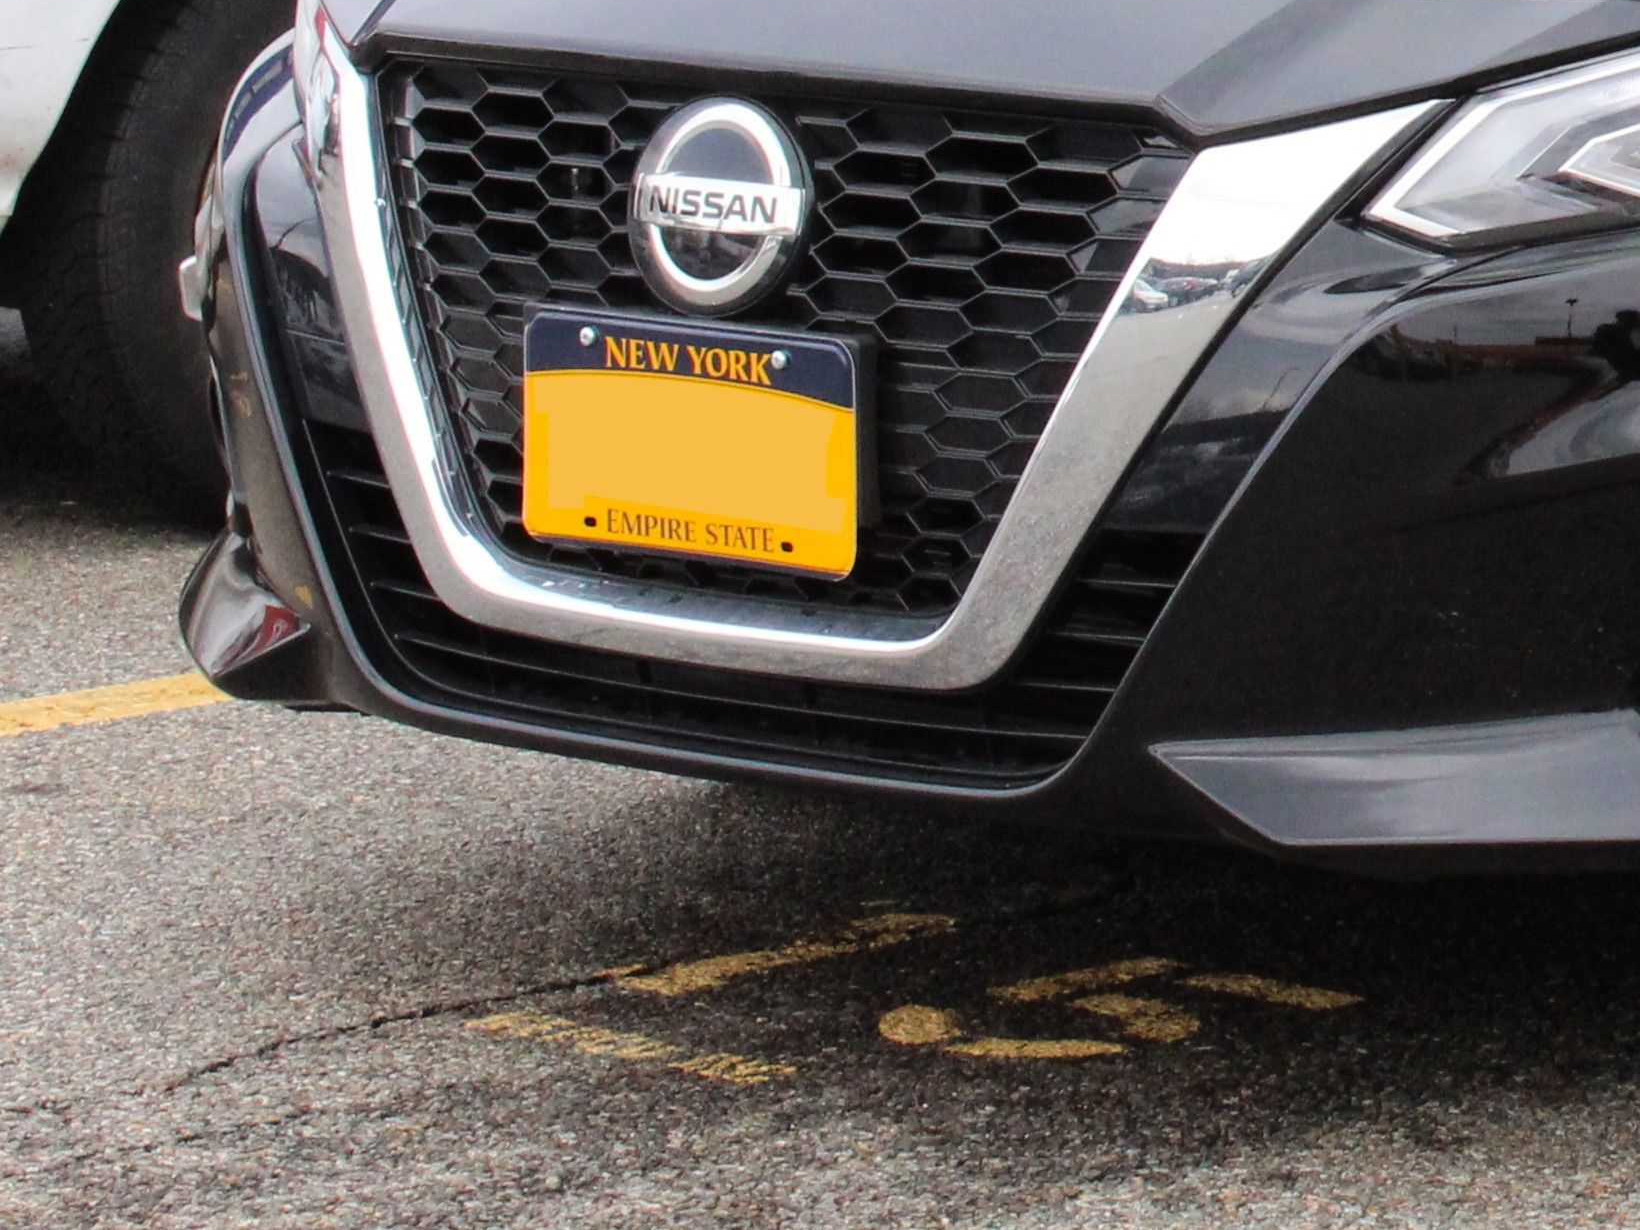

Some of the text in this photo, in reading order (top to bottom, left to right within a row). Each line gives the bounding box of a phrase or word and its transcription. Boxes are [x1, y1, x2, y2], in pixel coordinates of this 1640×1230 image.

[649, 174, 778, 224] NISSAN
[604, 336, 772, 386] NEW YORK
[606, 508, 774, 553] EMPIRE STATE
